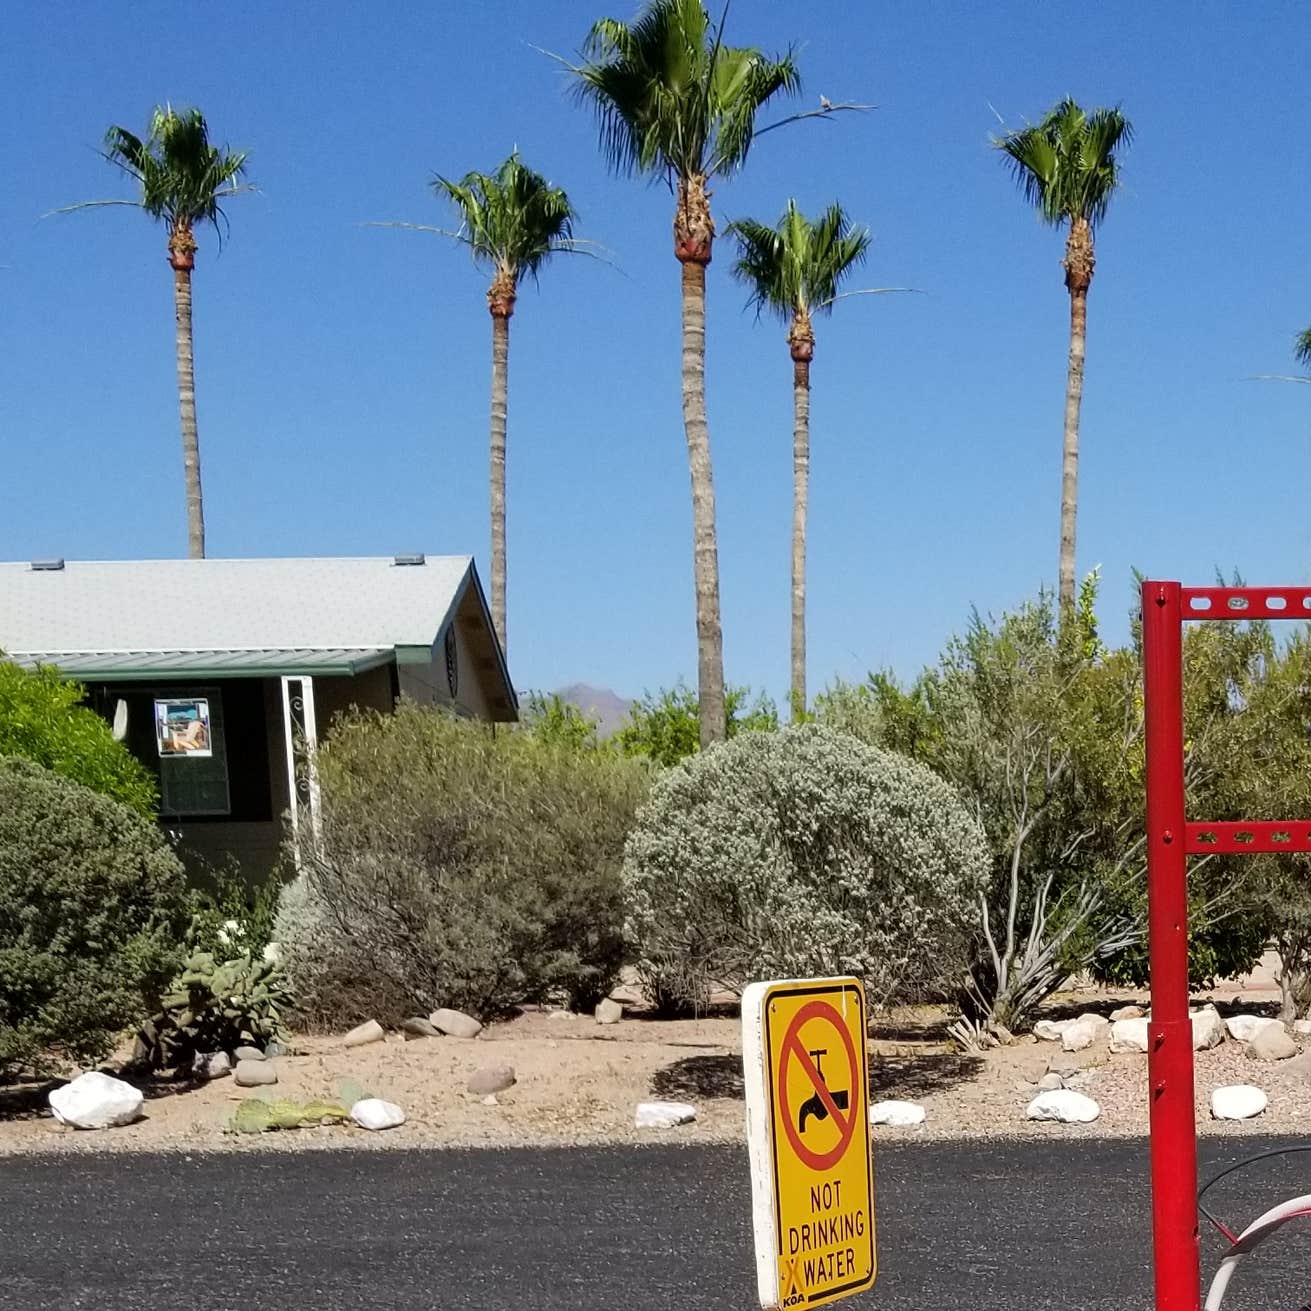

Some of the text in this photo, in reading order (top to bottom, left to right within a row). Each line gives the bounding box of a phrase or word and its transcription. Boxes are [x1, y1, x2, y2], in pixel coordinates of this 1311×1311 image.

[810, 1180, 841, 1214] NOT
[789, 1210, 864, 1255] DRINKING
[804, 1248, 856, 1287] WATER
[783, 1294, 805, 1308] KOA
